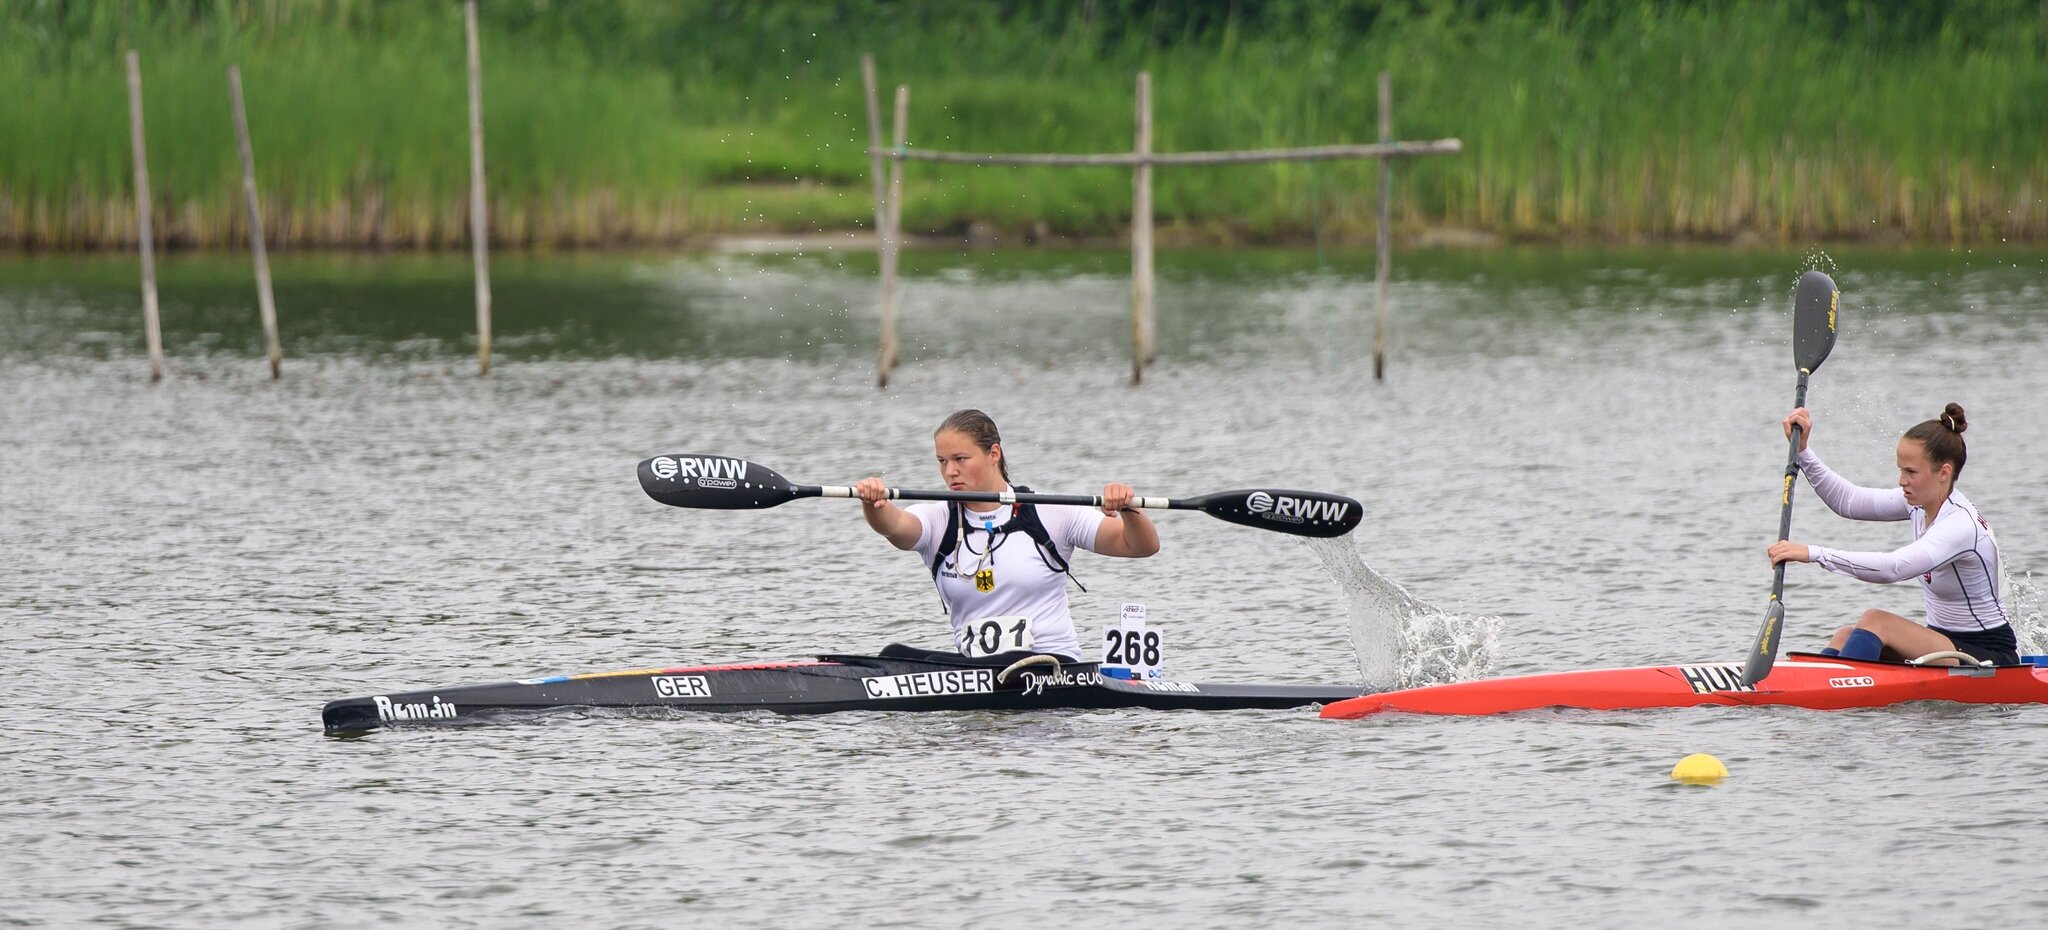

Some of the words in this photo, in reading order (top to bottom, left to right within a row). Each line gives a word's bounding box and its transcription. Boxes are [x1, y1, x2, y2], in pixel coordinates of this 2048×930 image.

[680, 457, 747, 480] RWW
[1275, 497, 1348, 522] RWW
[962, 619, 1026, 657] 101
[1106, 629, 1160, 666] 268
[656, 677, 708, 696] GER
[865, 678, 890, 697] C.
[894, 671, 992, 695] HEUSER
[1020, 670, 1075, 696] Dynaic
[1831, 678, 1873, 686] NELO
